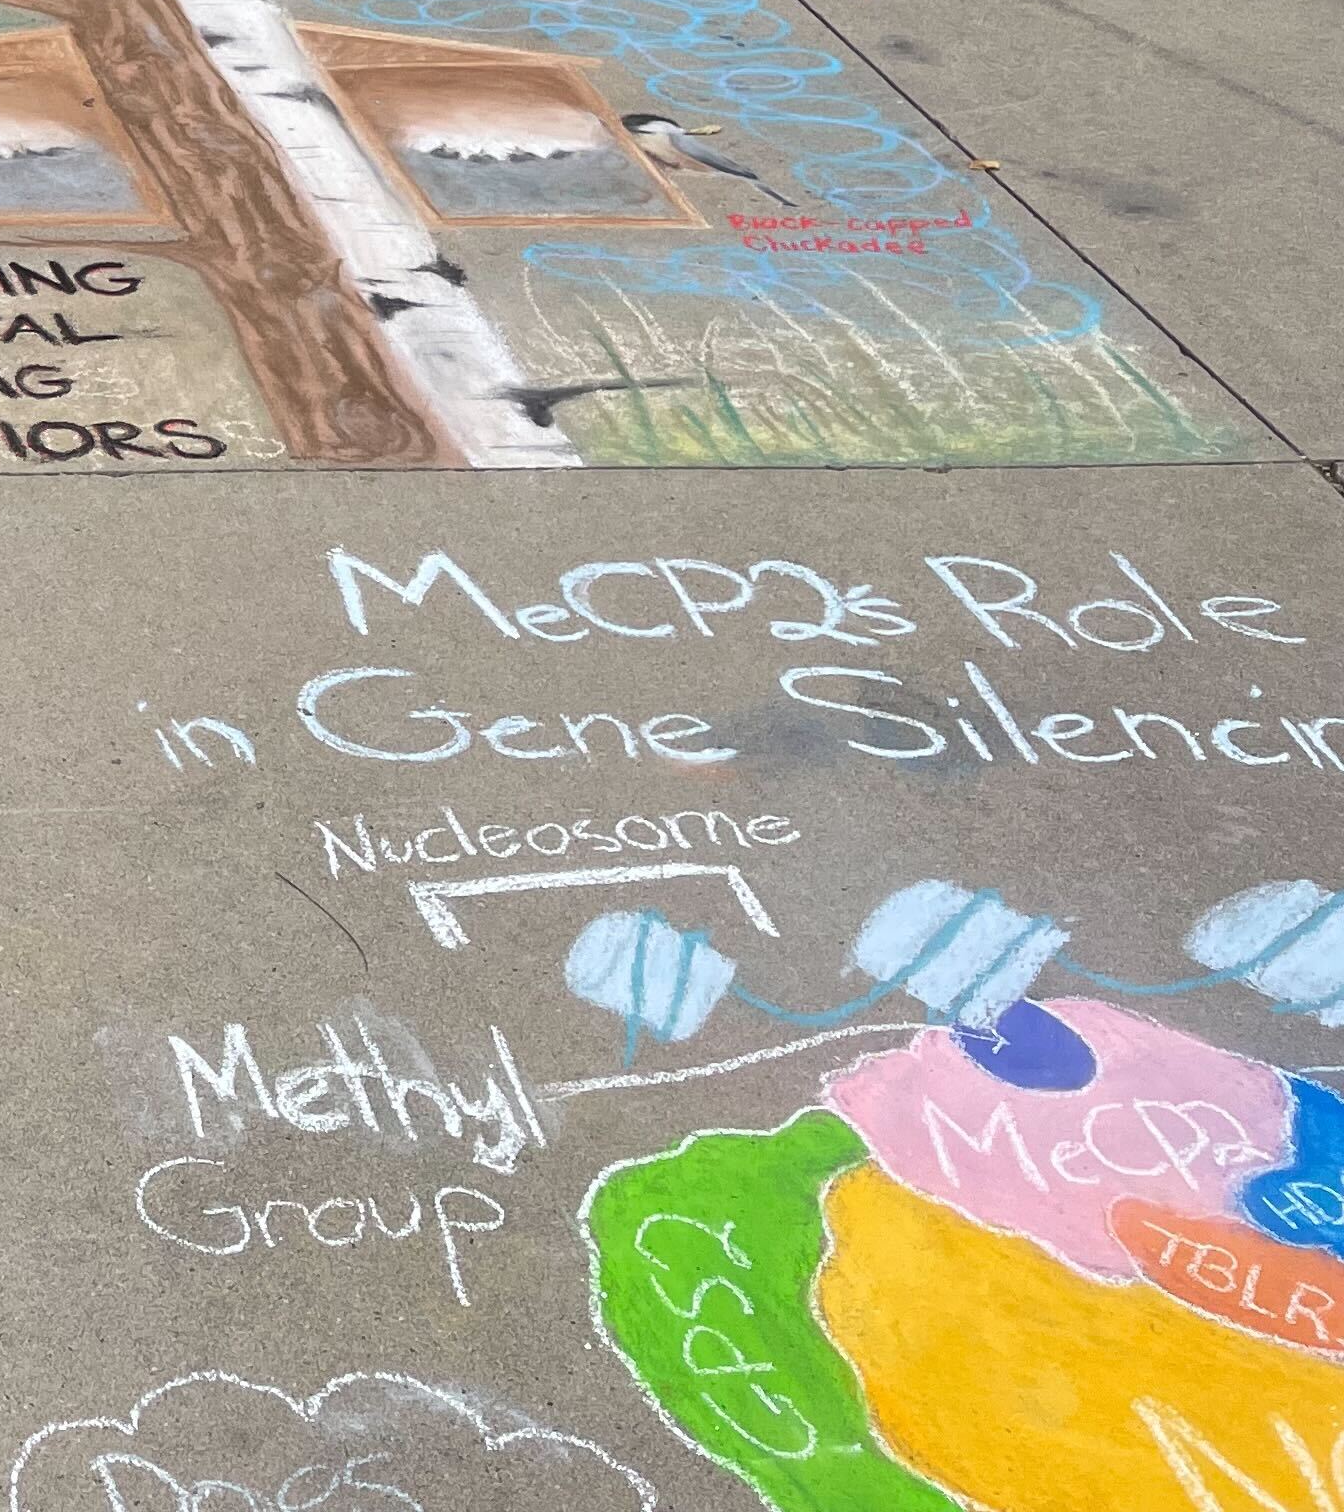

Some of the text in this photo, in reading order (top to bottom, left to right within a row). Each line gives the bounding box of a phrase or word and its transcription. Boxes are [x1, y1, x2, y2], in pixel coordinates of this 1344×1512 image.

[924, 547, 1308, 652] Role
[136, 700, 259, 772] in
[296, 664, 738, 766] Gene
[313, 805, 802, 882] Nucleosome
[166, 1016, 548, 1175] Methyl
[134, 1155, 507, 1308] Group
[1141, 1220, 1344, 1345] TBLR
